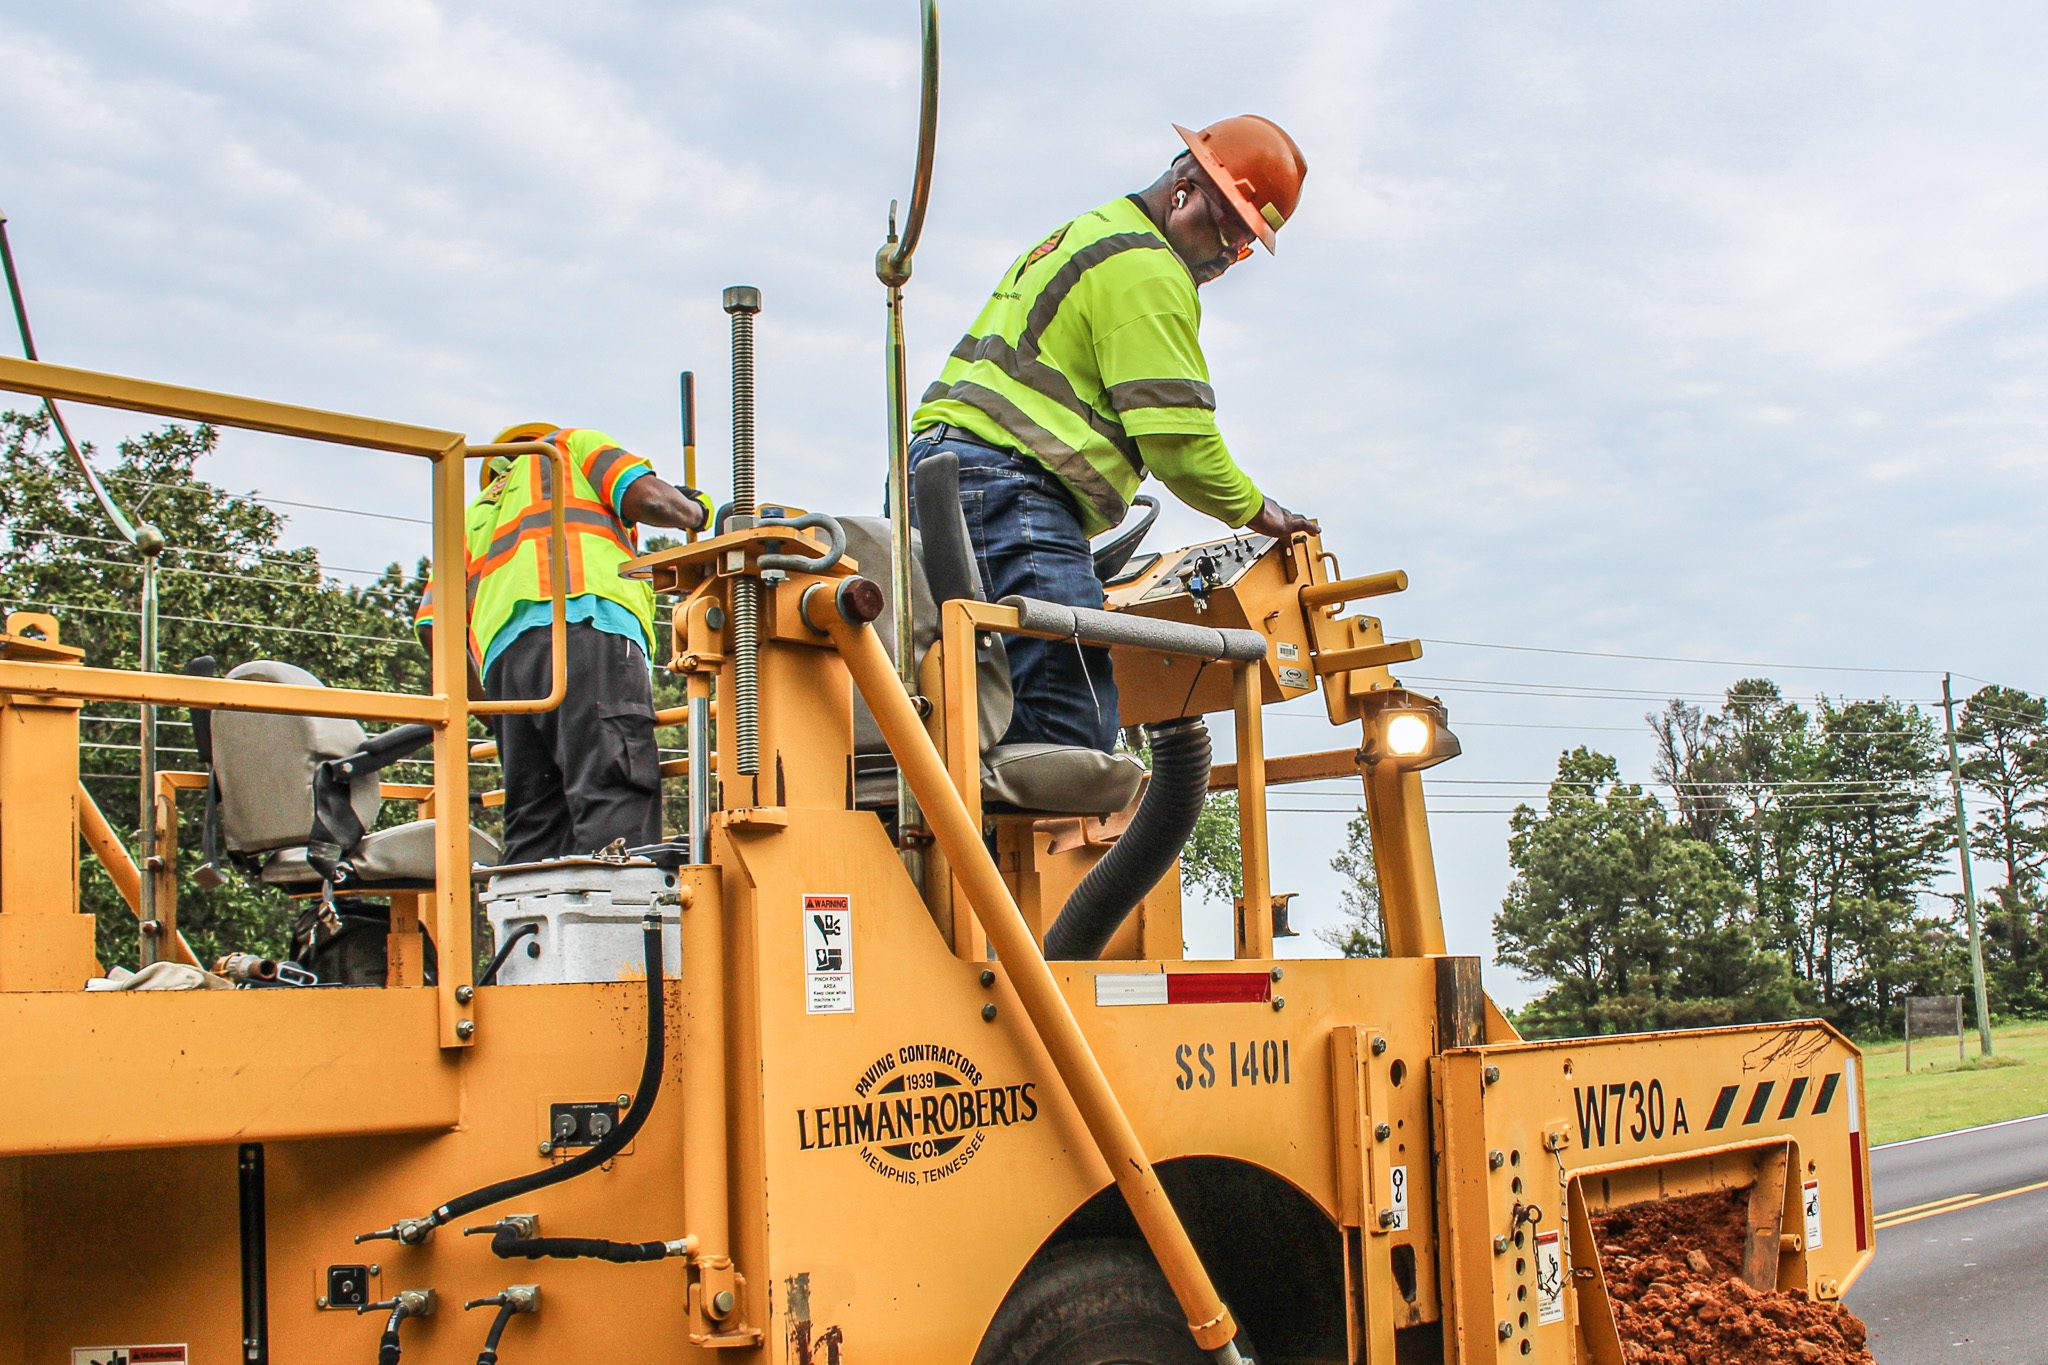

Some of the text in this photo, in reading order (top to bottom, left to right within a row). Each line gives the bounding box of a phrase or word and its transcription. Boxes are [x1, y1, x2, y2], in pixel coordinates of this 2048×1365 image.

[815, 899, 847, 908] WARNING
[855, 1044, 983, 1098] PAVING CONTRACTORS
[906, 1072, 933, 1091] 1939
[1175, 1039, 1290, 1091] SS 1401
[796, 1082, 1039, 1151] LEHMAN-ROBERTS
[1573, 1078, 1690, 1150] W730 A
[859, 1129, 986, 1187] MEMPHIS, TENNESSEE
[911, 1140, 938, 1160] CO.
